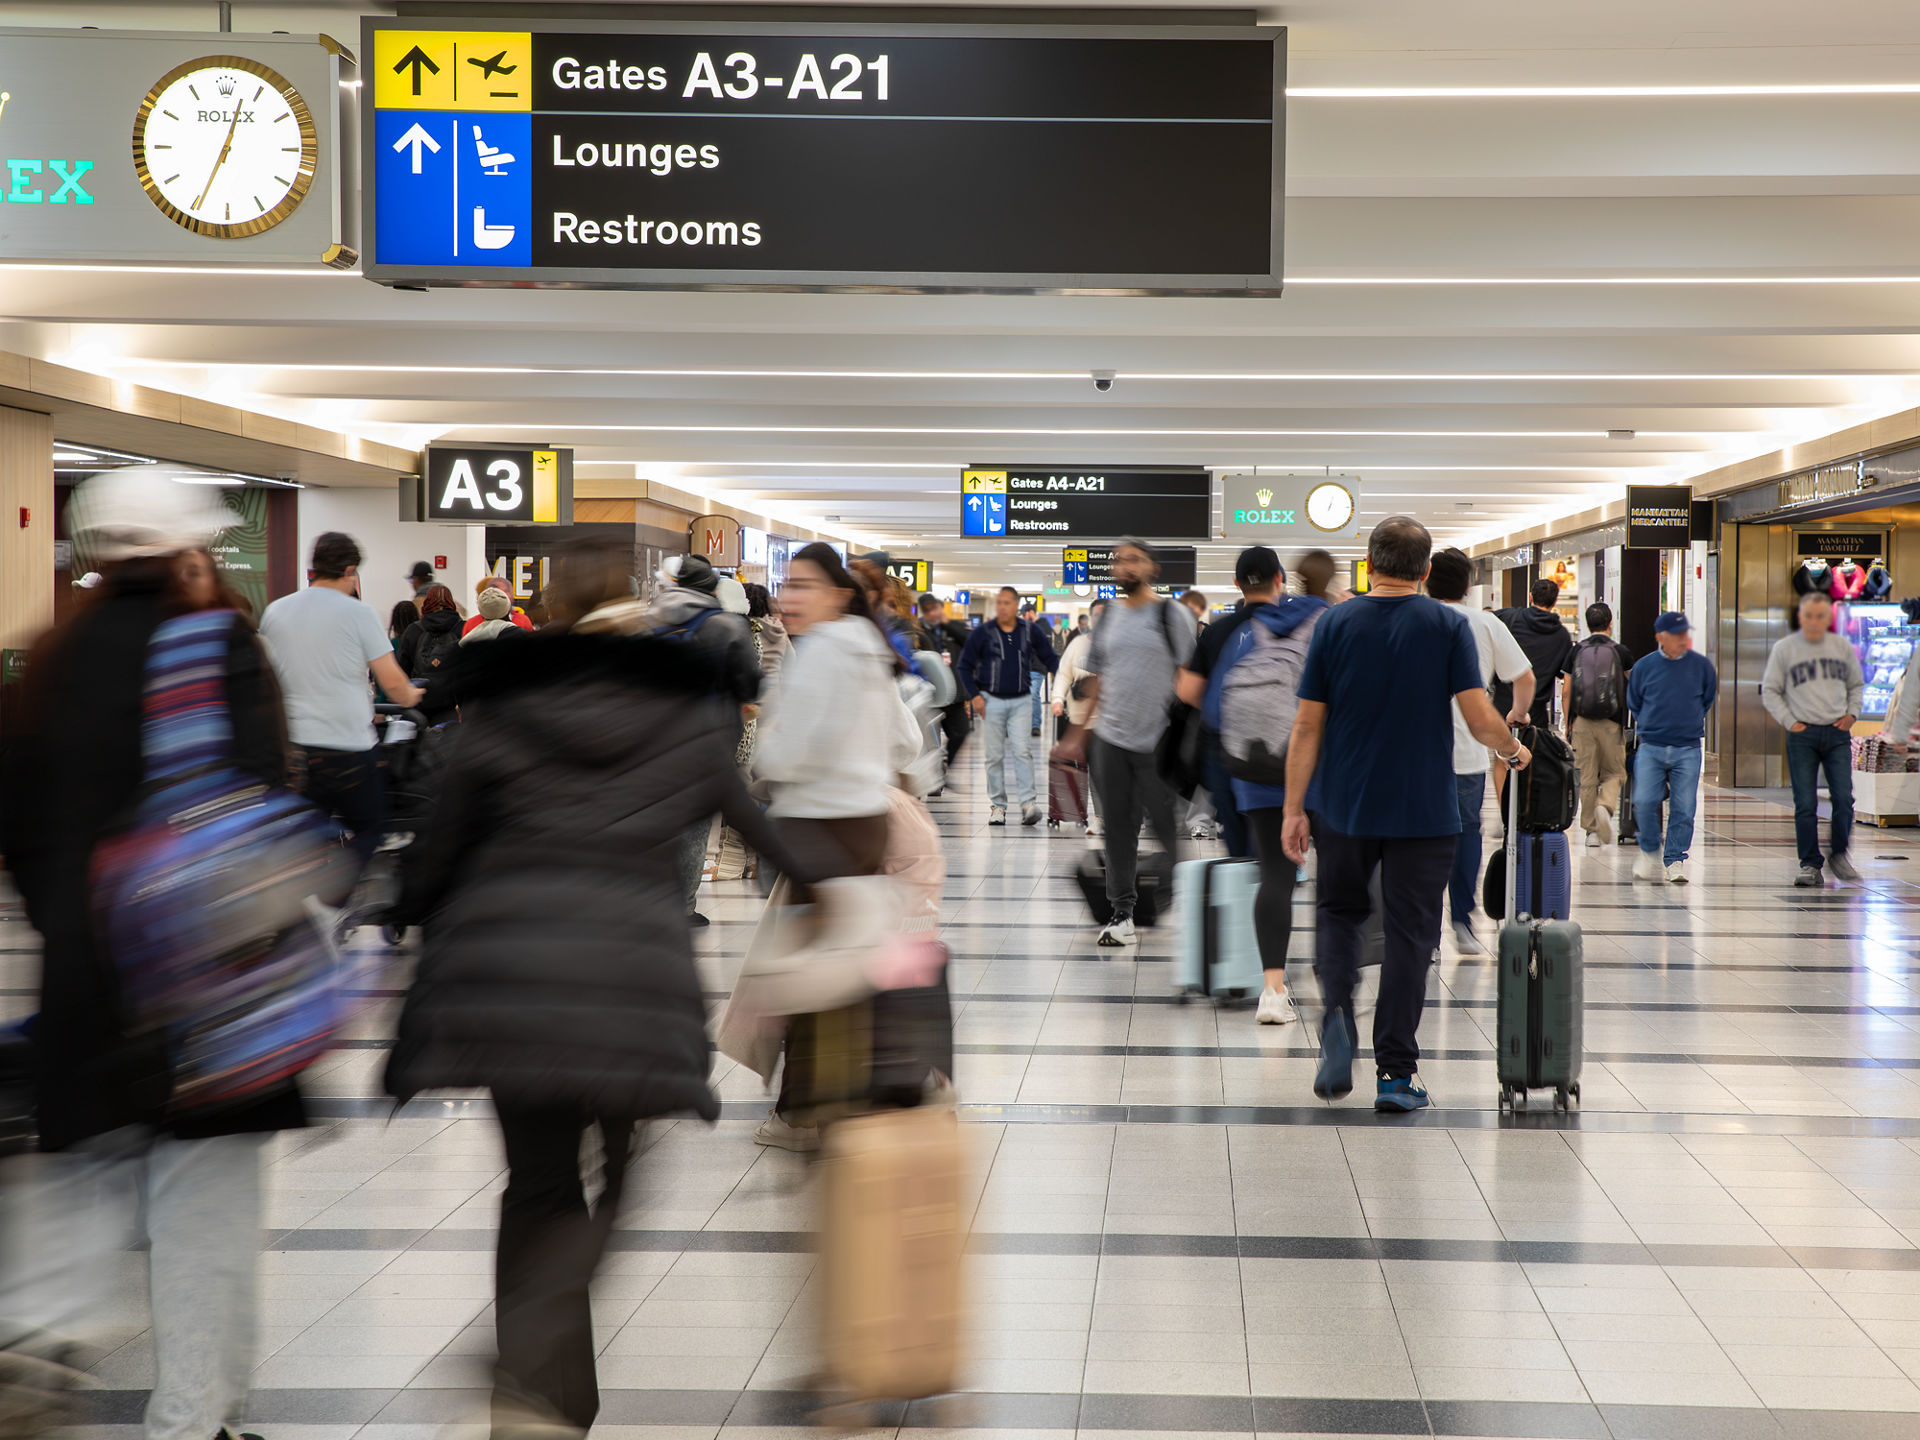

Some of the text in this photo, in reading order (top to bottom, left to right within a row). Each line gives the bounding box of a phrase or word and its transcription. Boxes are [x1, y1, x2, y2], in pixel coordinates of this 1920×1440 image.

[552, 51, 889, 101] Gates A3-A21
[197, 109, 255, 123] ROLEX
[553, 134, 720, 176] Lounges
[0, 158, 94, 205] EX
[553, 211, 762, 246] Restrooms
[439, 459, 523, 511] A3
[1010, 475, 1105, 491] Gates A4-A21
[1010, 498, 1058, 512] Lounges
[1631, 508, 1689, 517] MANHATTAN
[1010, 519, 1070, 531] Restrooms
[1233, 509, 1295, 524] ROLEX
[1631, 517, 1688, 527] MERCANTILE
[706, 528, 725, 556] M
[1088, 552, 1107, 560] Gates
[885, 565, 915, 587] A5
[1790, 658, 1817, 688] NEW
